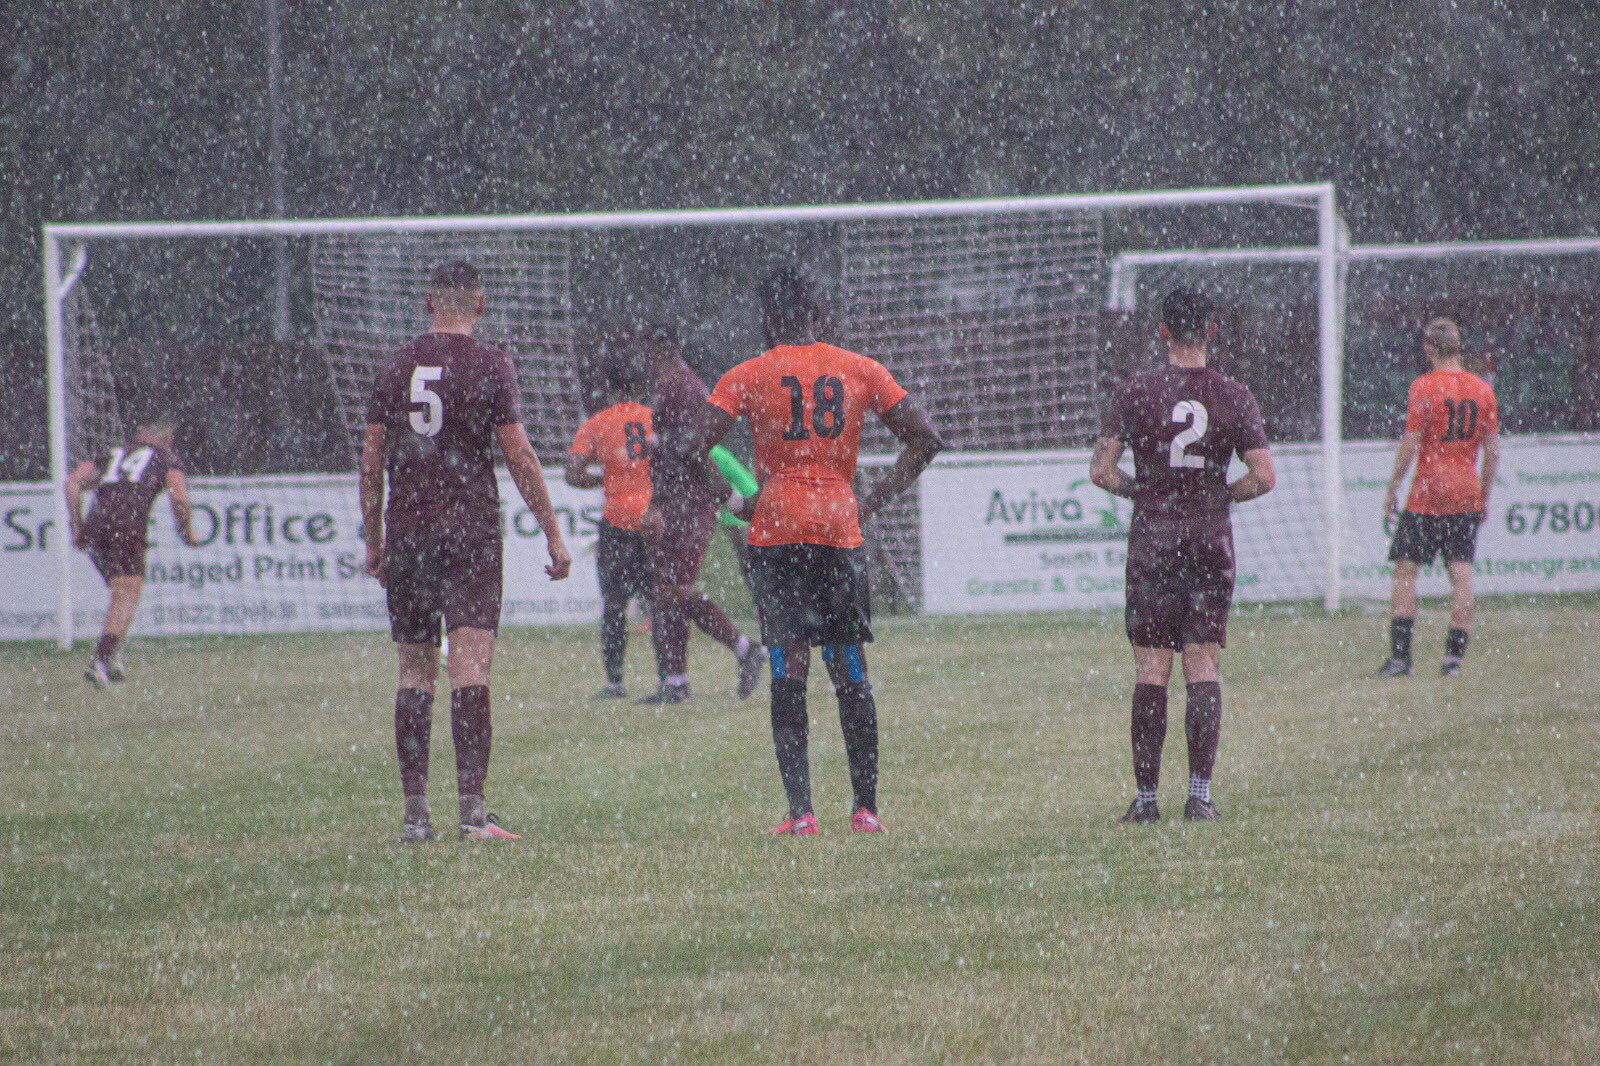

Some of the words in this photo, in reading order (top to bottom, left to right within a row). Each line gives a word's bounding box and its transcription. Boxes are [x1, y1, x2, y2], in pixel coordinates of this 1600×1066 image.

[409, 366, 444, 437] 5
[780, 374, 846, 440] 18
[1440, 398, 1479, 442] 10
[624, 421, 648, 461] 8
[1169, 400, 1209, 468] 2
[101, 447, 155, 483] 14
[984, 489, 1083, 526] Aviva
[1505, 501, 1600, 535] 6780
[149, 554, 244, 590] naged
[254, 555, 328, 582] Print
